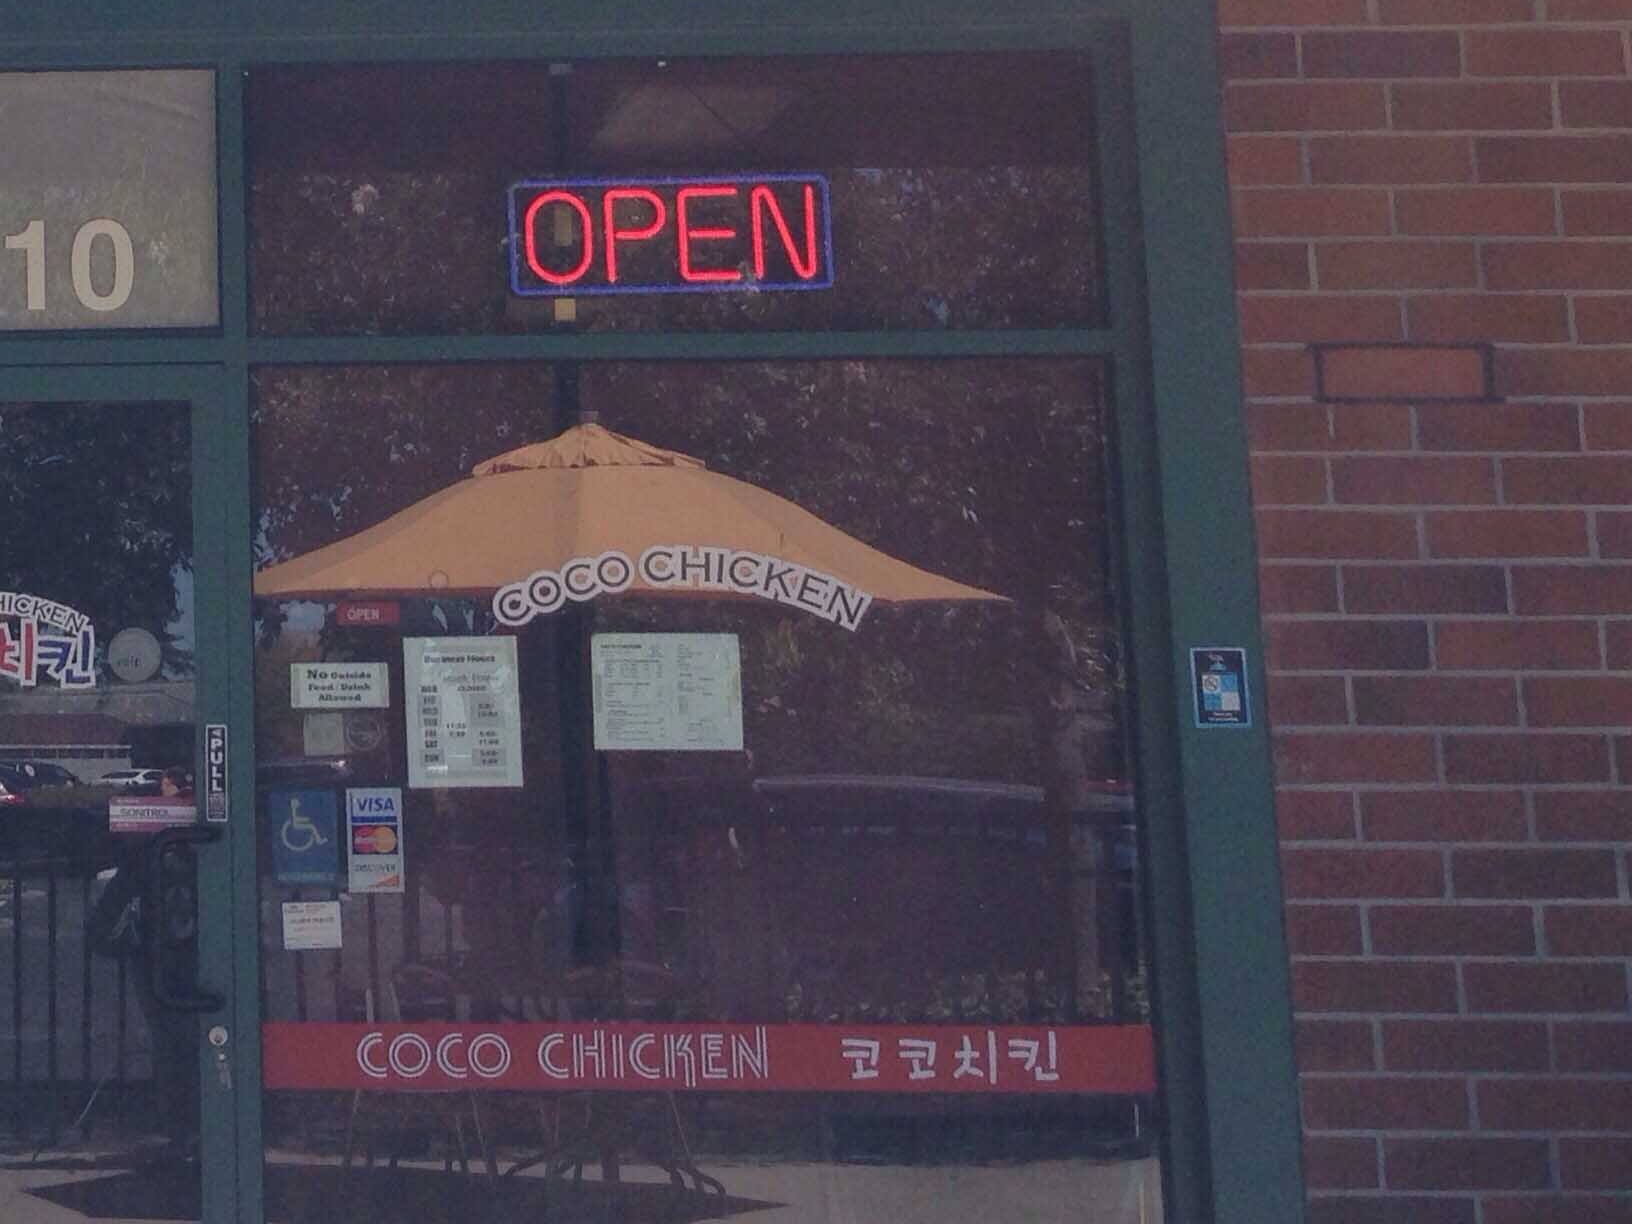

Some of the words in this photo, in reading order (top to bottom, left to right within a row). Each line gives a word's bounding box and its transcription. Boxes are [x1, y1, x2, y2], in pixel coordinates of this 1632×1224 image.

[523, 184, 818, 284] OPEN
[346, 607, 381, 621] OPEN
[495, 552, 633, 625] COCO
[640, 546, 871, 630] CHICKEN
[307, 669, 328, 680] No
[318, 693, 362, 702] Allowed
[210, 737, 224, 793] PULL
[357, 797, 395, 812] VISA
[356, 1032, 511, 1079] COCO
[537, 1026, 768, 1087] CHICKEN
[840, 1030, 1060, 1084] 코코치킨
